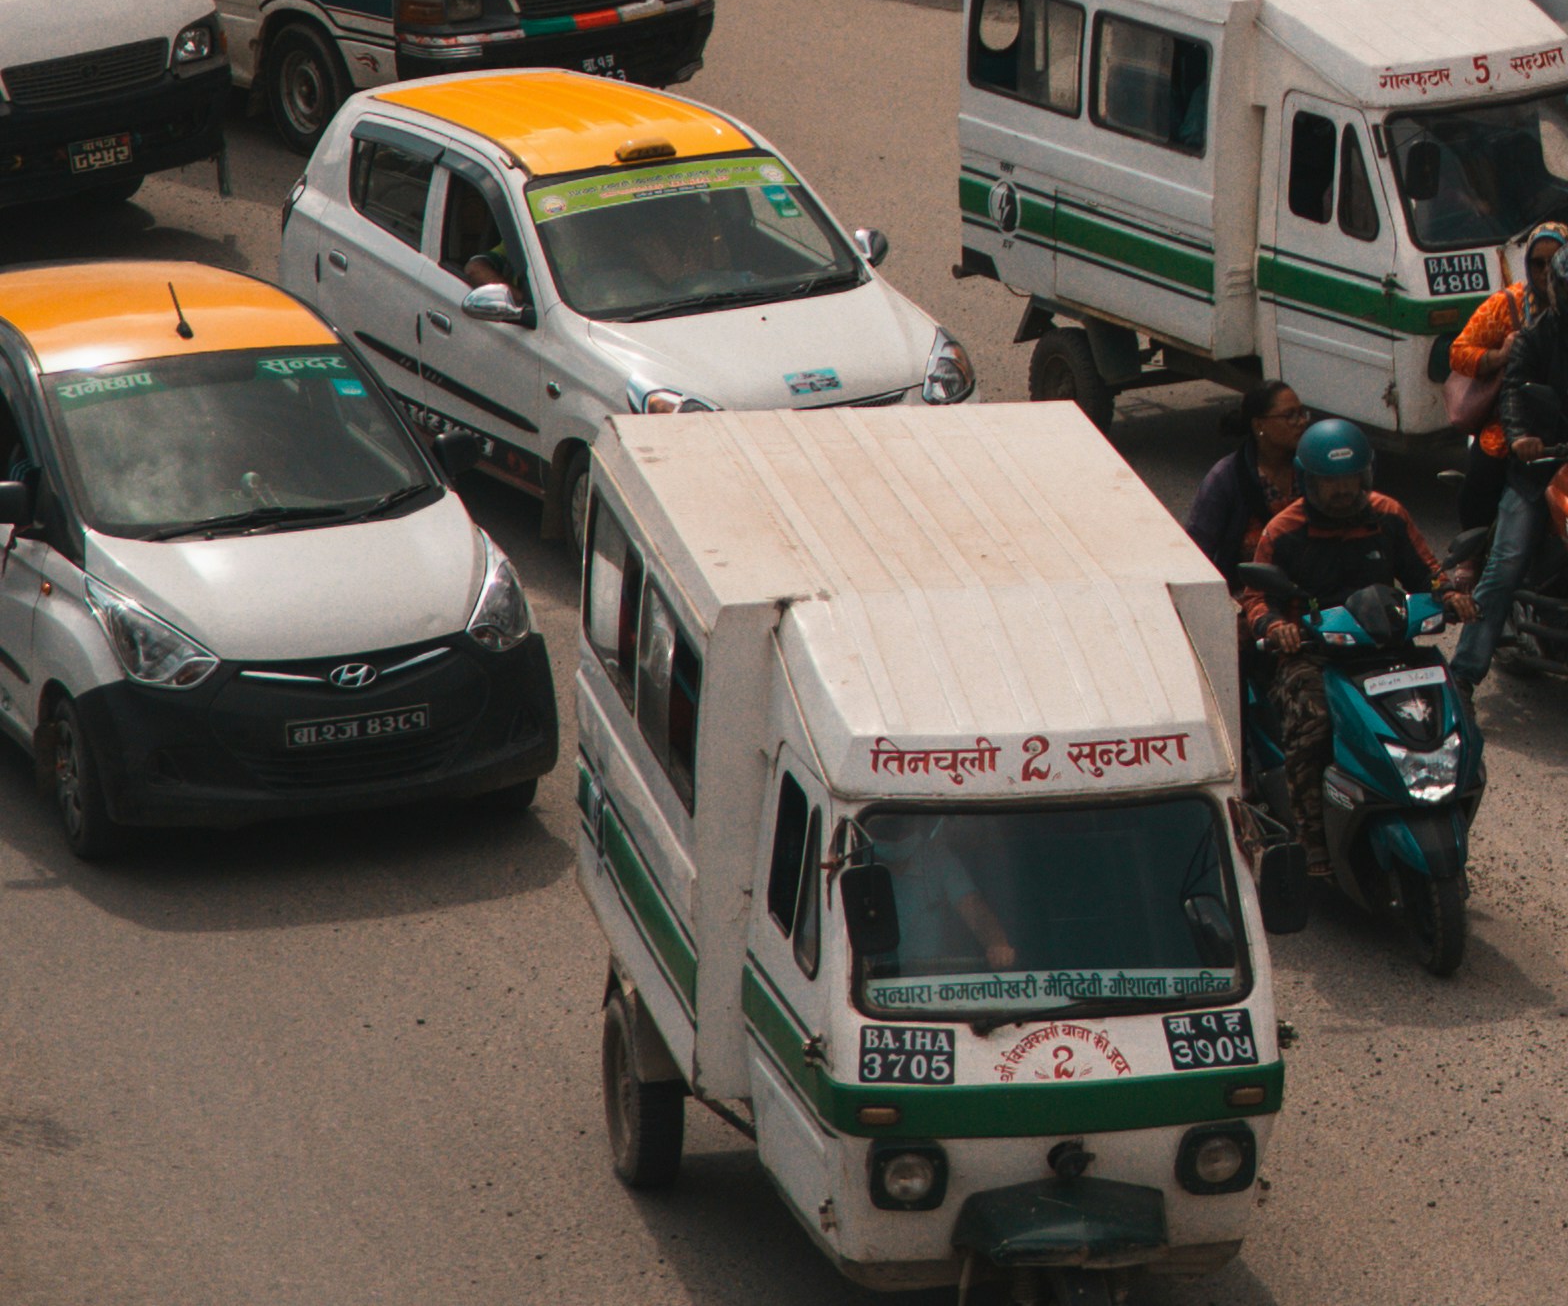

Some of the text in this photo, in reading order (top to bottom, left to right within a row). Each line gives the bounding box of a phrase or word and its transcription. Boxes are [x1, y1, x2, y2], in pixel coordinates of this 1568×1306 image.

[1472, 55, 1490, 84] 5
[1432, 273, 1484, 294] 4819
[257, 356, 348, 376] सुन्दर
[366, 711, 426, 734] ४३८१
[869, 736, 1002, 785] तिनचुली
[1066, 733, 1190, 778] सुन्धारा
[865, 1029, 951, 1052] BA.1HA
[1094, 1029, 1110, 1054] की
[1106, 1047, 1132, 1075] जय
[1173, 1035, 1255, 1066] ३७०५
[863, 1052, 951, 1079] 3705
